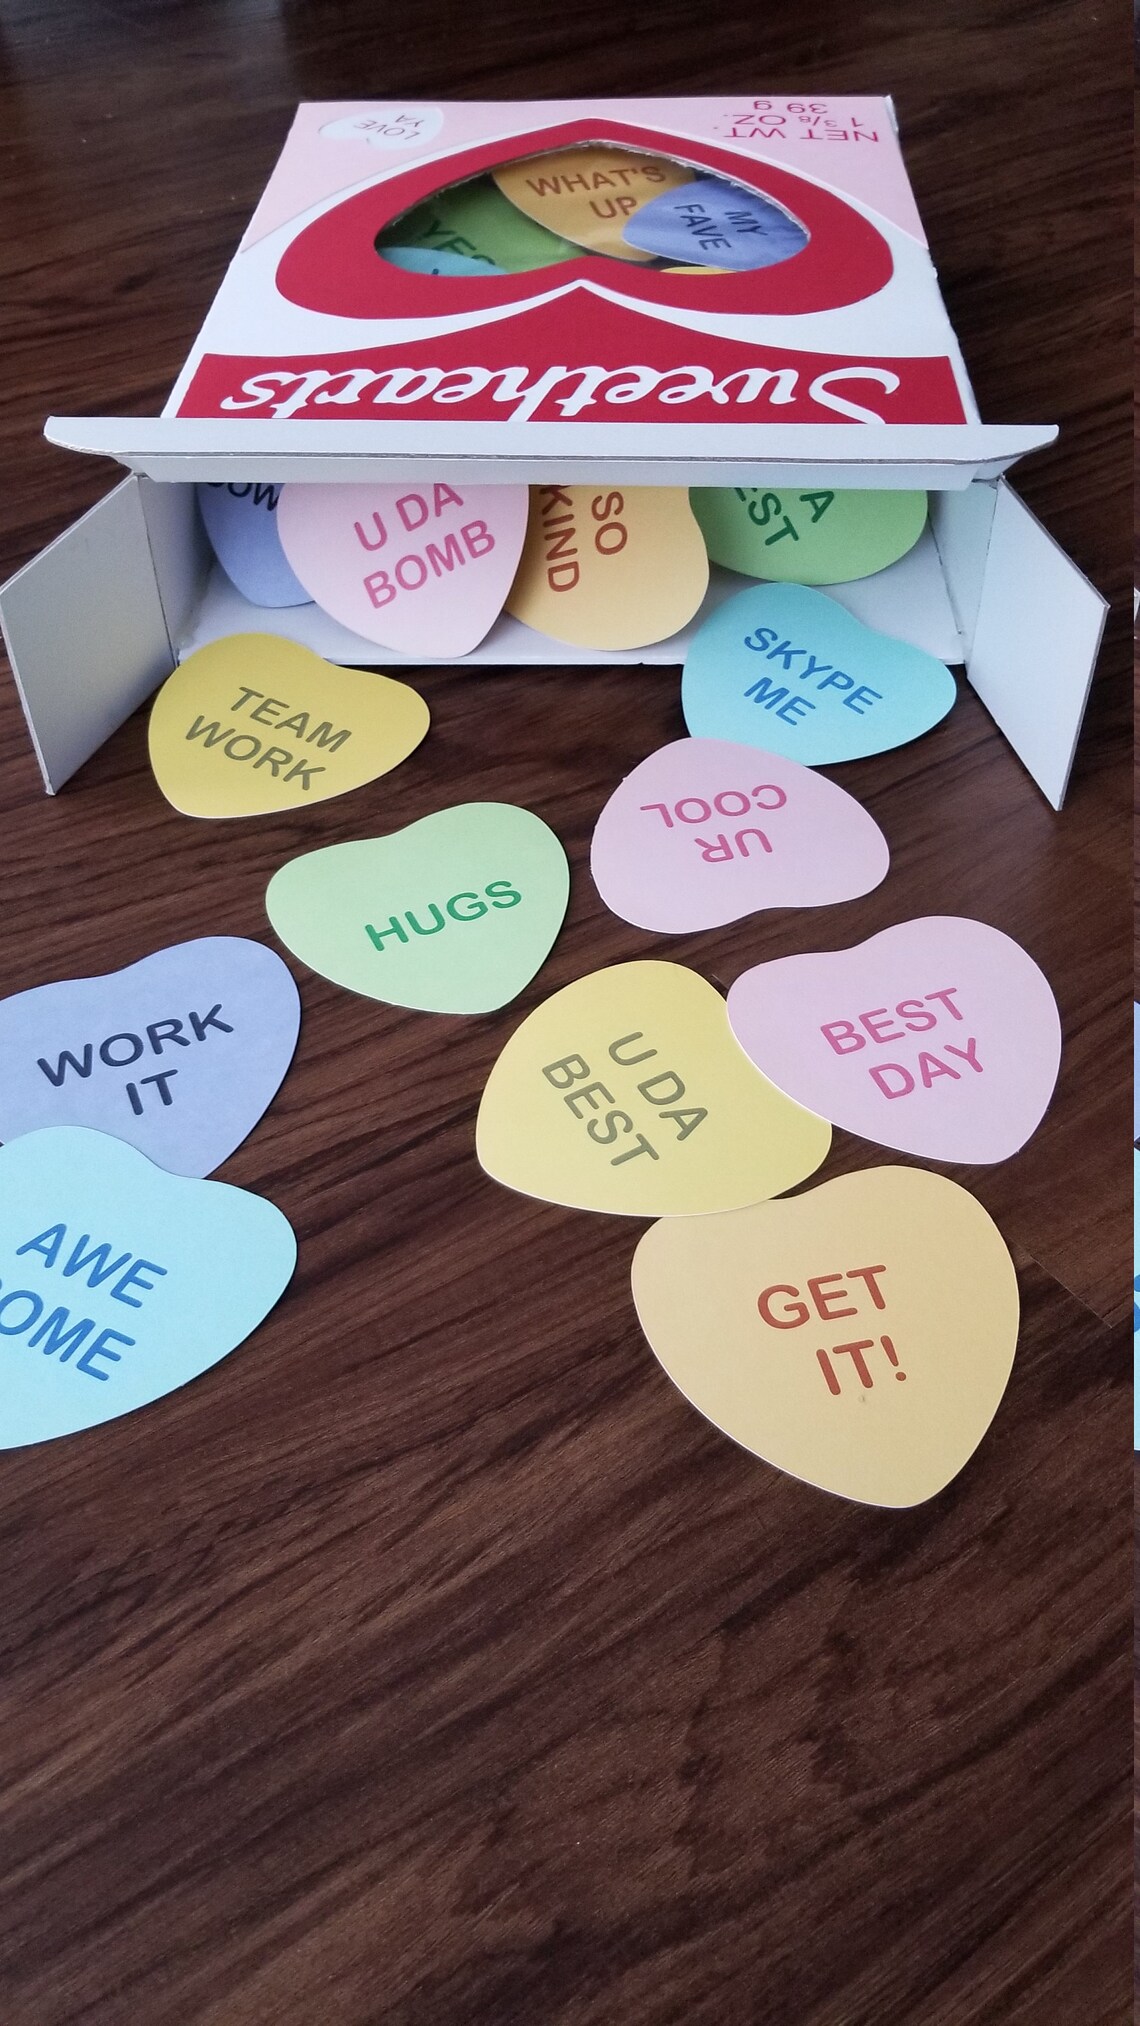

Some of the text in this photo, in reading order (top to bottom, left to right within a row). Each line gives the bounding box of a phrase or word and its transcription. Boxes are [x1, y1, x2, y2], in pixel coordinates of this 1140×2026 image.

[353, 120, 420, 140] LOVE
[395, 115, 424, 127] YA
[787, 103, 828, 114] 39
[801, 129, 879, 142] NET
[851, 117, 863, 127] 1
[525, 166, 666, 197] WHAT'S
[589, 196, 637, 219] UP
[674, 202, 732, 250] FAVE
[725, 209, 768, 236] MY
[219, 366, 900, 424] Sweethearts
[207, 483, 280, 511] OW
[354, 483, 464, 551] U DA
[591, 491, 628, 556] SO
[363, 520, 495, 609] BOMB
[541, 486, 580, 592] KIND
[744, 627, 883, 714] SKYPE
[230, 686, 352, 753] TEAM
[743, 677, 816, 726] ME
[185, 715, 326, 791] WORK
[640, 784, 787, 828] COOL
[694, 829, 773, 863] UR
[365, 881, 522, 951] HUGS
[37, 1003, 234, 1087] WORK
[820, 987, 963, 1055] BEST
[126, 1069, 178, 1115] IT
[608, 1031, 708, 1141] U DA
[868, 1037, 983, 1099] DAY
[542, 1053, 659, 1166] BEST
[16, 1223, 168, 1308] AWE
[757, 1264, 886, 1329] GET
[0, 1278, 136, 1381] OME
[816, 1335, 906, 1396] IT!
